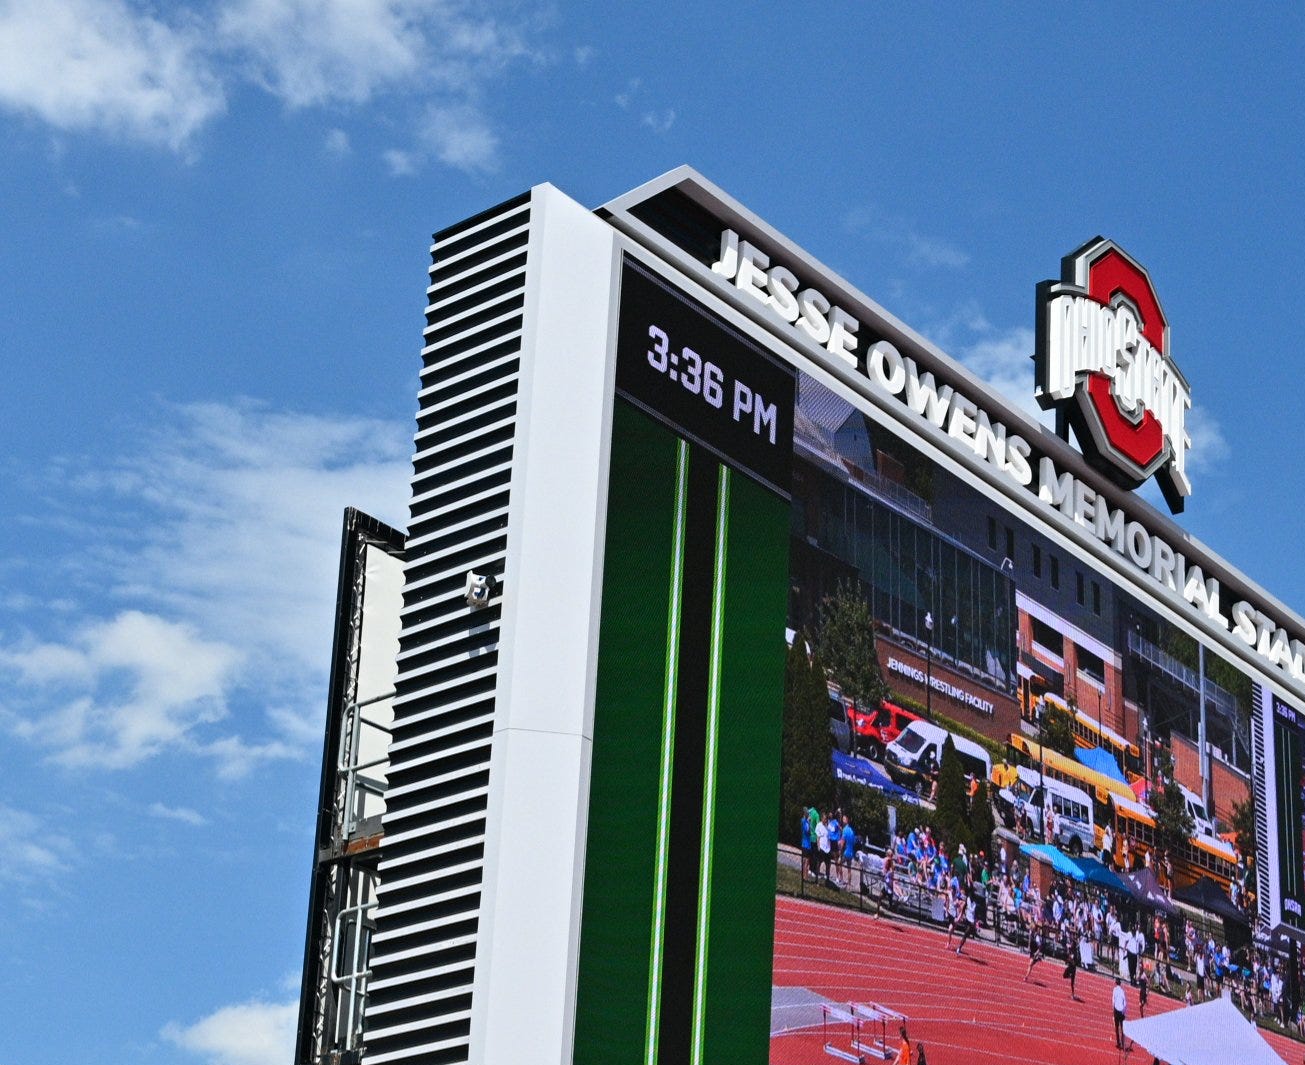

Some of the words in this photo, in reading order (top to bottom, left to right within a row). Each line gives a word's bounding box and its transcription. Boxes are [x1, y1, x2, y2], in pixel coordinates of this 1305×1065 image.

[647, 325, 724, 409] 3:36
[733, 379, 777, 445] PM
[712, 229, 860, 370] JESSE
[866, 340, 1033, 486] OWENS
[1039, 456, 1229, 628] MEMORIAL
[887, 657, 924, 683] JENNINGS
[964, 692, 994, 714] FACILITY
